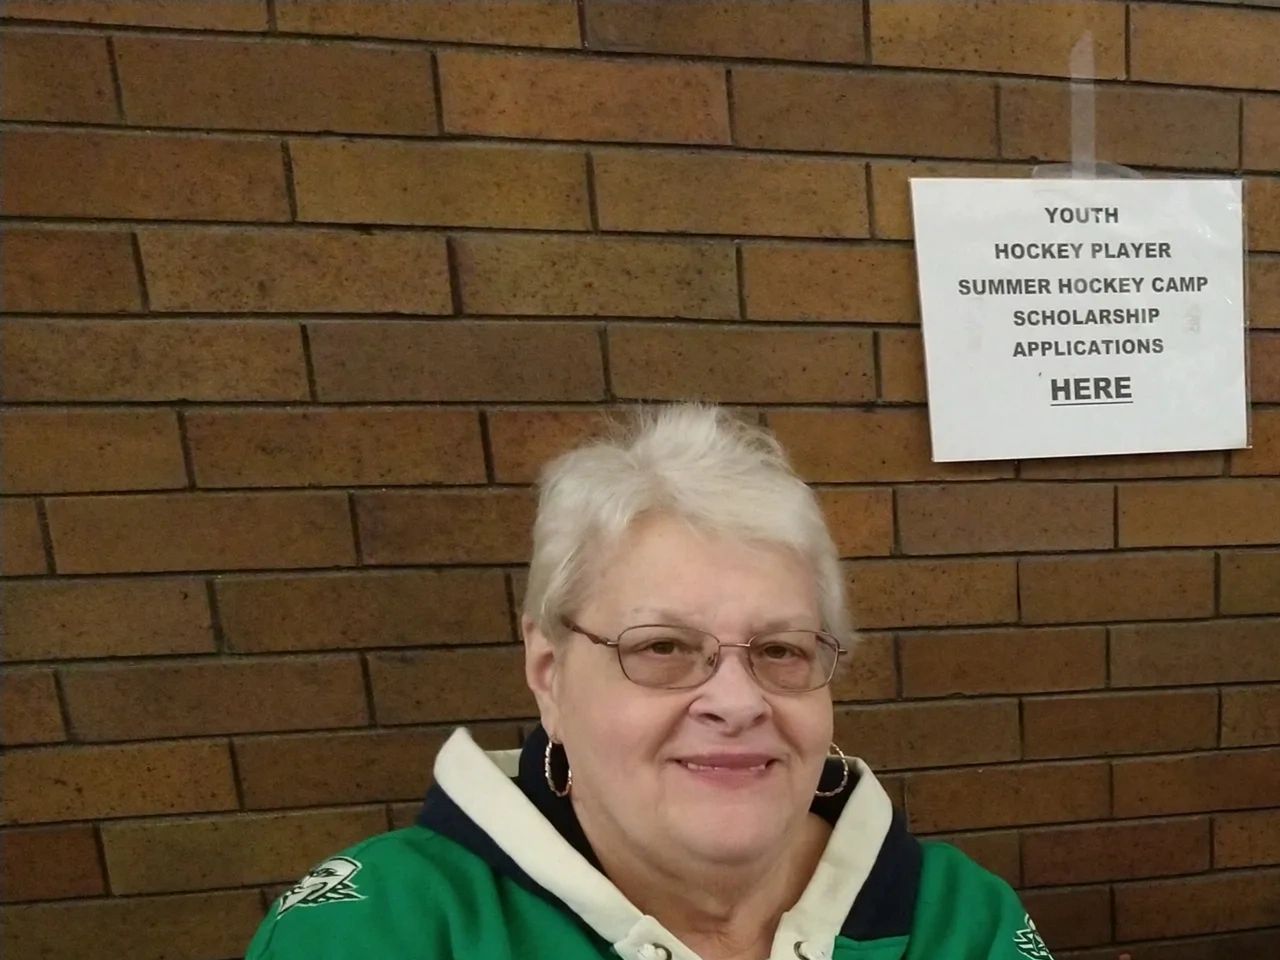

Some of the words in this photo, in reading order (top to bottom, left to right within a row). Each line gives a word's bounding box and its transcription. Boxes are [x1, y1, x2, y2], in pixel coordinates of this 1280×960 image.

[1045, 207, 1119, 223] YOUTH
[994, 243, 1083, 259] HOCKEY
[1091, 242, 1171, 258] PLAYER
[958, 278, 1051, 295] SUMMER
[1058, 277, 1144, 293] HOCKEY
[1151, 276, 1208, 292] CAMP
[1013, 308, 1159, 326] SCHOLARSHIP
[1012, 338, 1163, 357] APPLICATIONS
[1051, 376, 1132, 401] HERE
